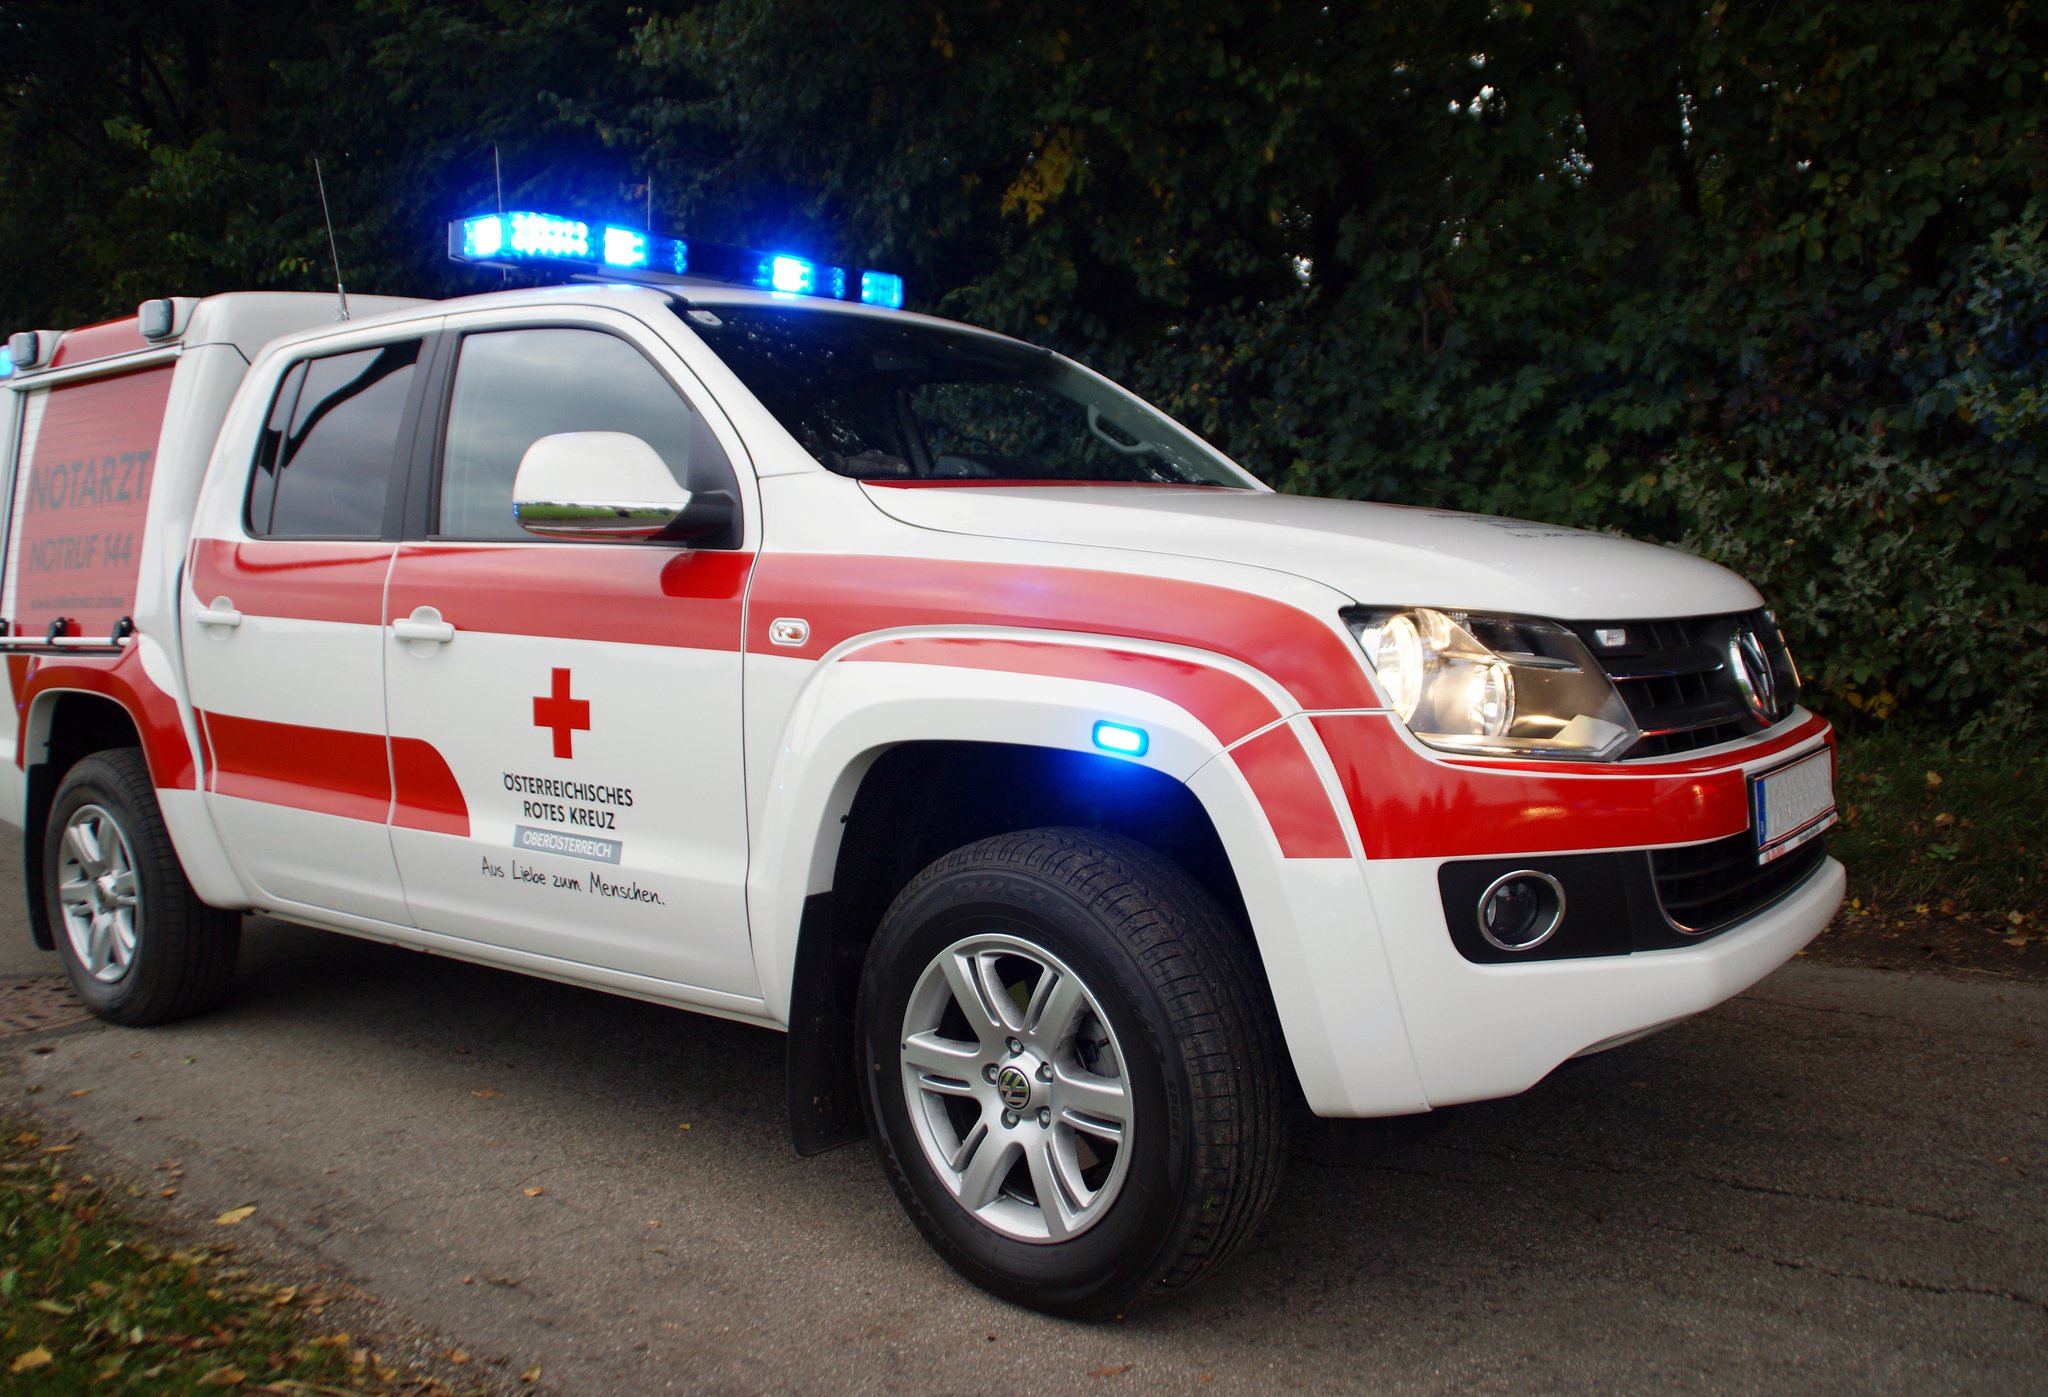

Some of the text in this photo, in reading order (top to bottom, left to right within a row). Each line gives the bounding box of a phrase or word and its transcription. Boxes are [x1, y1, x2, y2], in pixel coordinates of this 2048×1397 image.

[29, 450, 152, 512] NOTARZT
[30, 532, 133, 572] NOTRUF 144
[503, 772, 633, 806] ÖSTERREICHISCHES
[523, 800, 616, 830] ROTES KREUZ
[522, 829, 612, 859] OBERÖSTERREICH
[481, 855, 667, 906] Aus Liebe zum Menschen.
